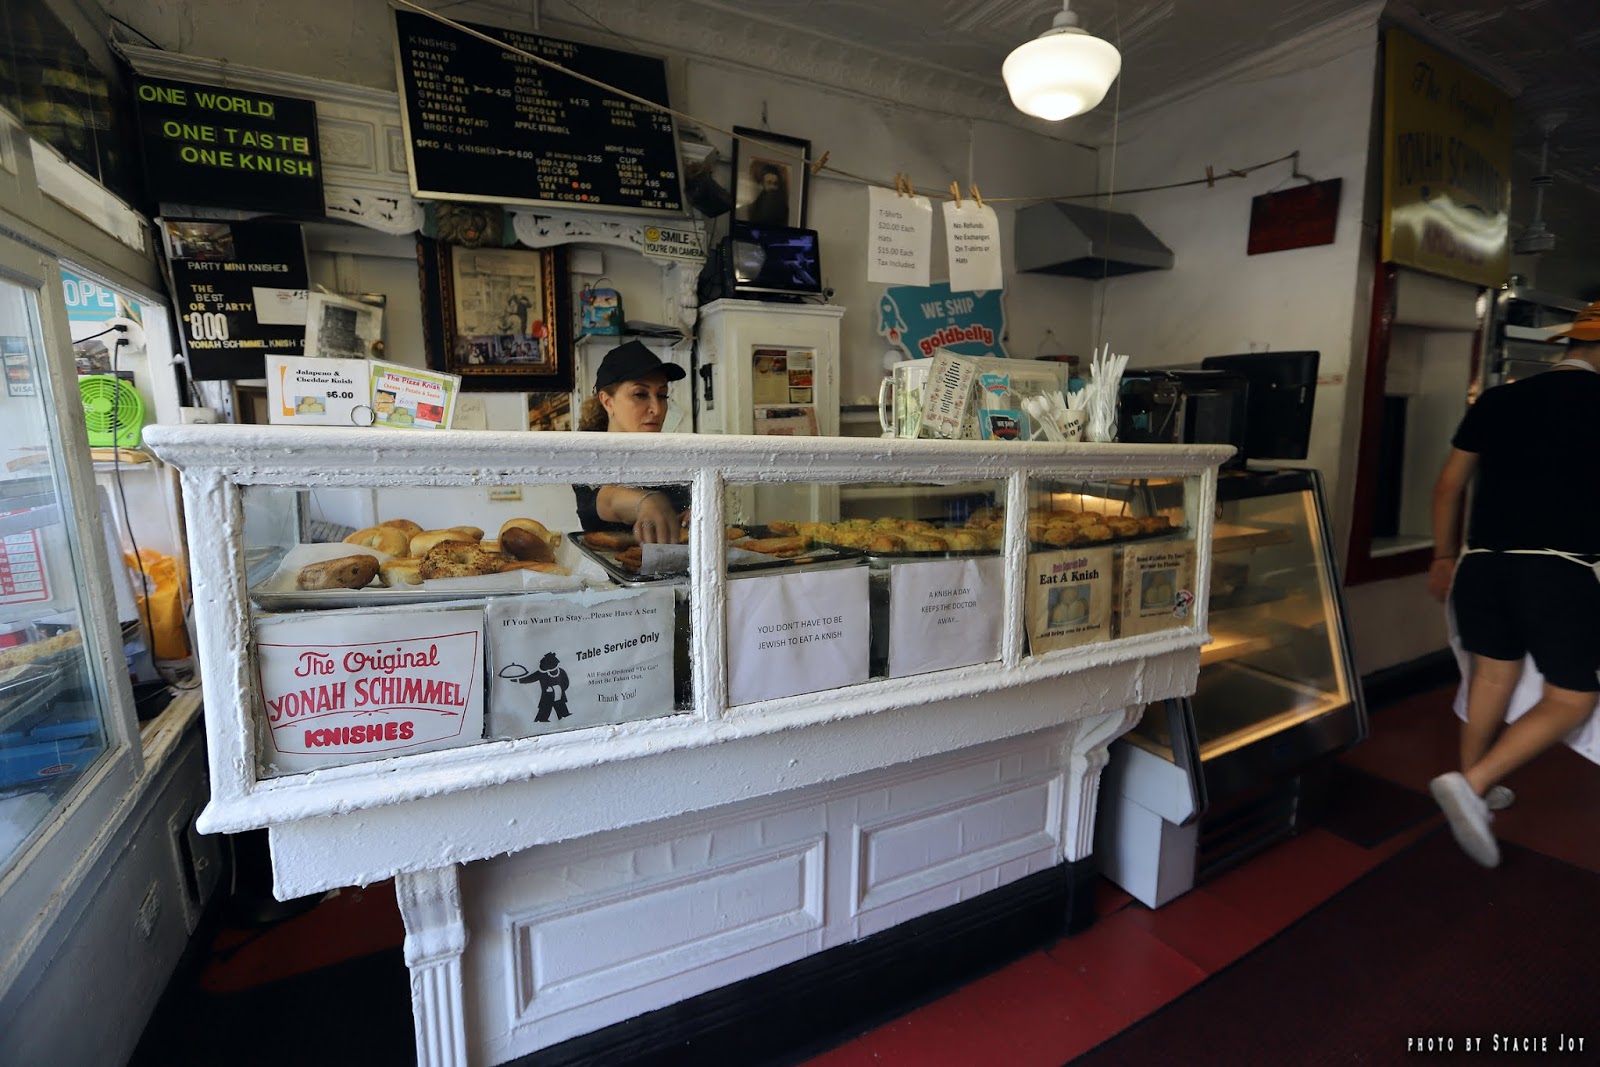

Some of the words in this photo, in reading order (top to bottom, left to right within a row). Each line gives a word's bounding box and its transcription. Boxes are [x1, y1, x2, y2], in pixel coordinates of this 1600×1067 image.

[409, 35, 457, 51] KNISHES
[412, 50, 449, 63] POTATO
[413, 60, 444, 72] KASHA
[515, 66, 537, 75] WITH
[515, 77, 542, 87] APPLE
[418, 90, 463, 103] SPINACH
[514, 85, 549, 96] CHERRY
[139, 85, 187, 106] ONE
[194, 92, 273, 117] WORLD
[418, 100, 467, 113] CABBAGE
[515, 94, 563, 108] BLUEBERRY
[422, 112, 453, 123] SWEET
[459, 118, 489, 128] POTATO
[529, 113, 556, 123] PLAIN
[423, 122, 473, 135] BROCCOLI
[163, 121, 215, 142] ONE
[224, 128, 306, 153] TASTE
[458, 144, 496, 155] KNISHES
[181, 146, 234, 167] ONE
[239, 153, 313, 177] KNISH
[538, 166, 563, 174] JUICE
[537, 175, 569, 184] COFFEE
[540, 182, 556, 190] TEA
[620, 188, 644, 196] QUART
[878, 222, 900, 231] $20.00
[901, 225, 915, 233] Each
[661, 231, 689, 244] SMILE
[646, 243, 668, 253] YOU'RE
[669, 246, 678, 254] ON
[679, 247, 705, 256] CAMERA
[878, 246, 898, 255] $15.00
[900, 249, 914, 257] Each
[188, 261, 220, 270] PARTY
[224, 263, 246, 271] MINI
[248, 264, 288, 272] KNISHES
[890, 261, 915, 269] Included
[62, 278, 115, 308] OPE
[191, 284, 214, 293] THE
[195, 293, 224, 302] BEST
[189, 303, 206, 311] OR
[217, 303, 252, 311] PARTY
[921, 301, 944, 319] WE
[945, 297, 974, 316] SHIP
[189, 340, 221, 349] YONAH
[222, 339, 268, 348] SCHIMMEL
[269, 339, 296, 348] KNISH
[919, 324, 994, 355] goldbelly
[402, 376, 420, 386] Pizza
[422, 381, 440, 390] Knish
[1040, 574, 1057, 585] Eat
[1060, 572, 1068, 582] A
[1071, 569, 1099, 581] Knish
[934, 590, 952, 598] KNISH
[922, 604, 939, 613] KEEPS
[941, 603, 951, 611] THE
[953, 601, 977, 609] DOCTOR
[503, 619, 510, 627] If
[531, 617, 551, 625] Want
[554, 615, 564, 623] To
[776, 622, 799, 632] DON'T
[801, 619, 820, 628] HAVE
[822, 617, 832, 625] TO
[576, 649, 601, 661] Table
[603, 638, 638, 655] Service
[640, 631, 660, 644] Only
[758, 641, 786, 650] JEWISH
[800, 635, 813, 644] EAT
[821, 631, 842, 640] KNISH
[294, 651, 335, 678] The
[343, 644, 441, 675] Original
[612, 667, 635, 675] Ordered
[267, 681, 347, 722] YONAH
[354, 676, 465, 708] SCHIMMEL
[597, 693, 619, 702] Thank
[621, 689, 637, 700] You!
[304, 721, 414, 748] KNISHES
